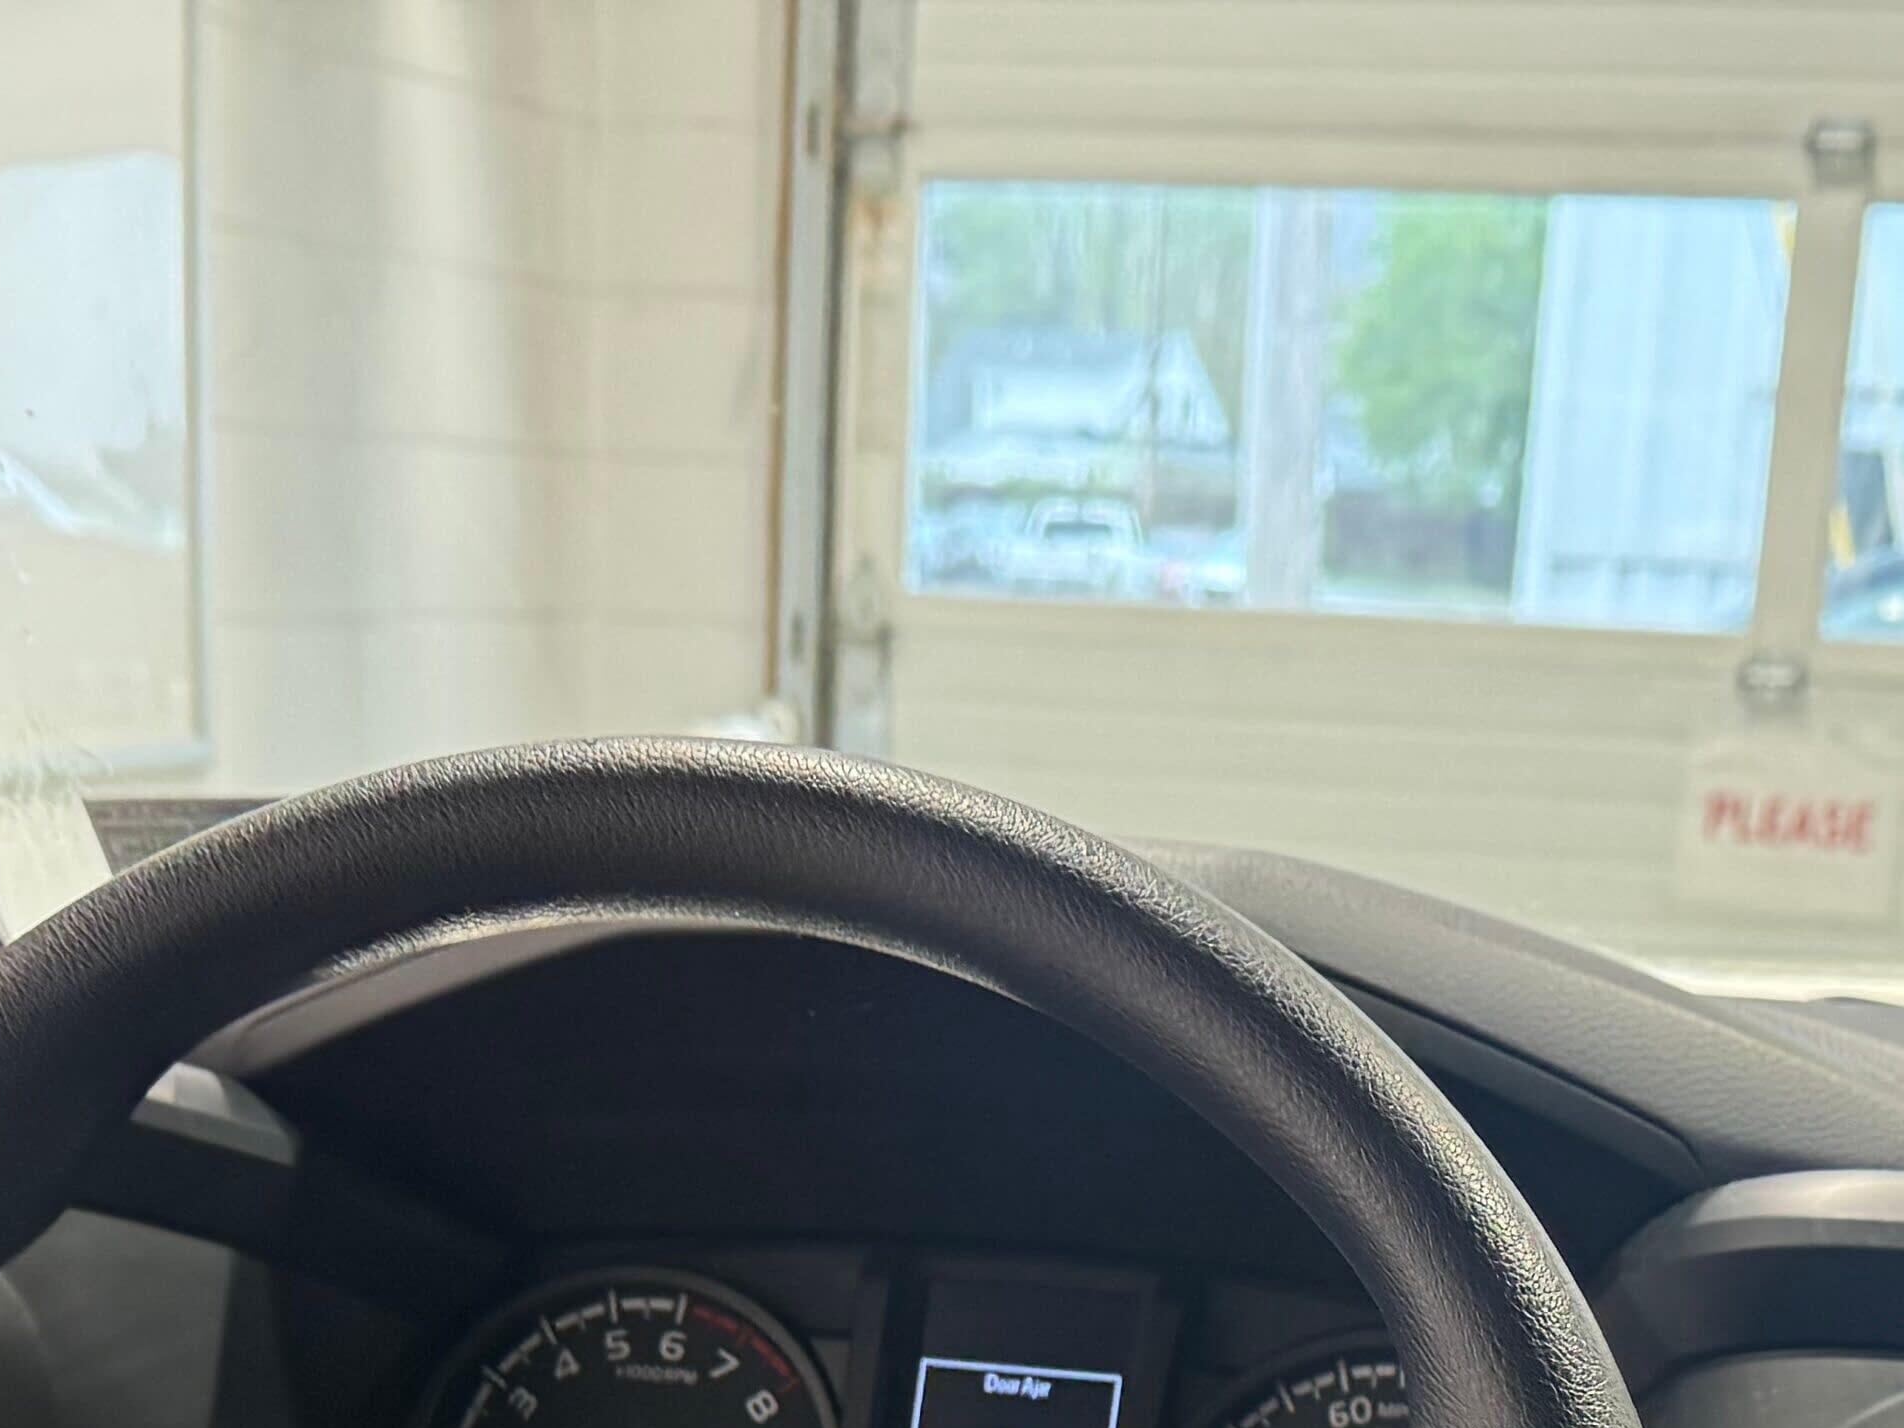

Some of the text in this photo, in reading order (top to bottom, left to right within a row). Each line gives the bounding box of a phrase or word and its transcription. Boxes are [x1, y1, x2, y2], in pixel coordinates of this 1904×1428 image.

[1703, 789, 1878, 854] PLEASE
[604, 1330, 632, 1361] 5
[658, 1330, 688, 1361] 6
[554, 1349, 581, 1381] 4
[708, 1347, 742, 1378] 7
[507, 1386, 538, 1420] 3
[746, 1389, 780, 1425] 8
